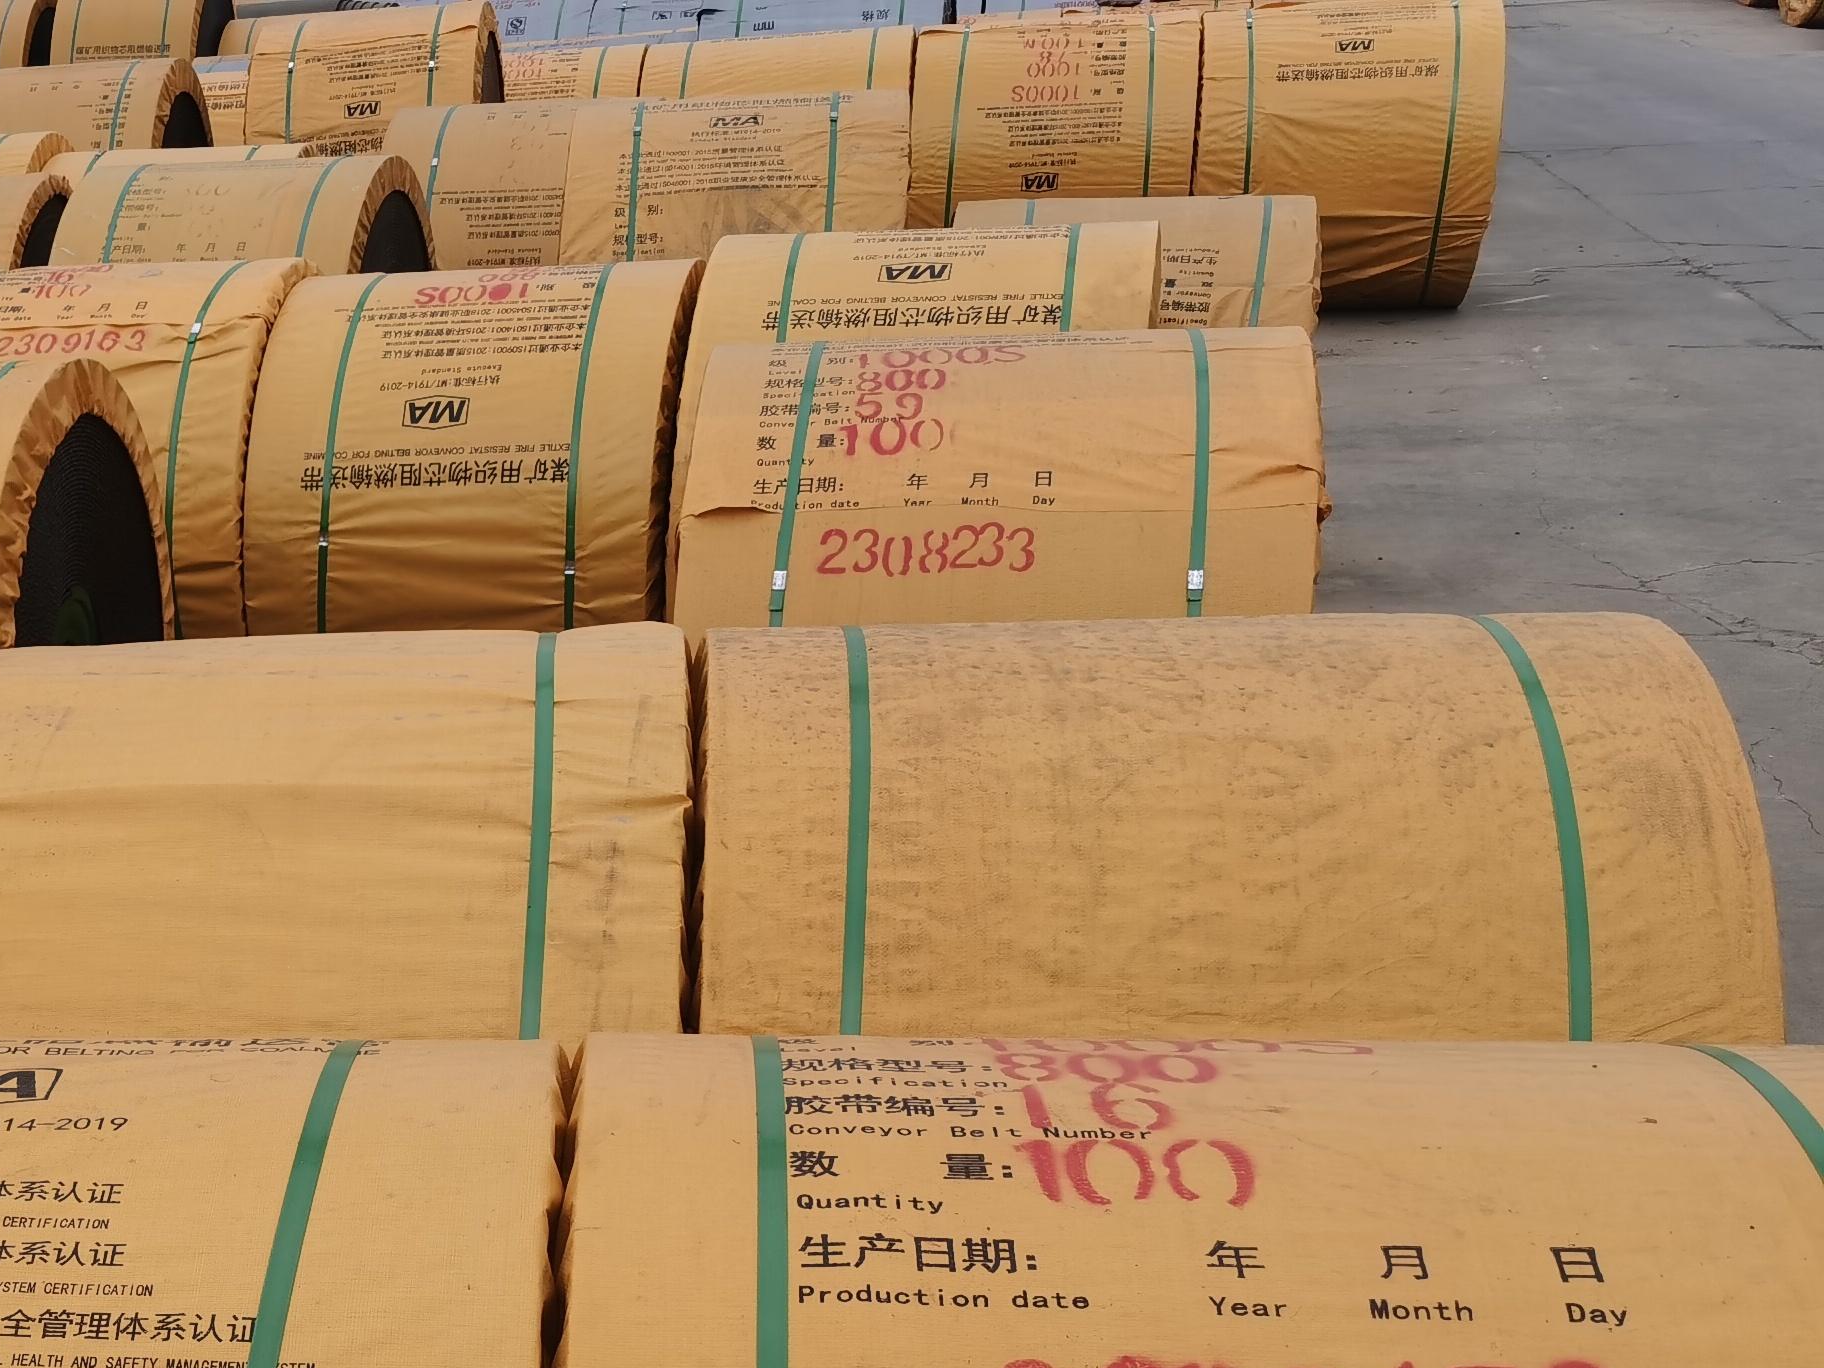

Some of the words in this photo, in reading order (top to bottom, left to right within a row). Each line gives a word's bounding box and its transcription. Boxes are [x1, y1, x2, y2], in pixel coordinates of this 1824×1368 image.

[856, 367, 946, 392] 800
[756, 436, 778, 451] 数
[839, 418, 945, 456] 100
[416, 446, 465, 457] CONVEYOR
[906, 473, 928, 492] 年
[969, 472, 989, 489] 月
[1034, 471, 1053, 488] 日
[830, 499, 860, 509] date
[1032, 495, 1056, 507] Day
[817, 521, 1036, 578] 2308233
[781, 1057, 993, 1074] 规格型号:
[996, 1051, 1221, 1086] 800
[781, 1075, 1009, 1090] Specification
[784, 1093, 1005, 1118] 胶带编号:
[1021, 1080, 1176, 1133] 16
[788, 1123, 929, 1138] Conveyor
[950, 1124, 1023, 1139] Belt
[1042, 1126, 1152, 1140] Number
[788, 1150, 840, 1178] 数
[939, 1153, 1014, 1181] 量:
[1013, 1138, 1258, 1209] 100
[796, 1193, 944, 1215] Quantity
[2, 1215, 110, 1230] CERTIFICATION
[797, 1235, 1040, 1276] 生产日期:
[1205, 1240, 1266, 1280] 年
[1379, 1245, 1431, 1283] 月
[1549, 1247, 1606, 1284] 日
[43, 1281, 154, 1297] CERTIFICATION
[797, 1285, 992, 1311] Production
[1012, 1288, 1090, 1310] date
[1208, 1297, 1289, 1321] Year
[1369, 1298, 1475, 1324] Month
[1566, 1302, 1629, 1330] Day
[11, 1352, 64, 1368] HEALTH
